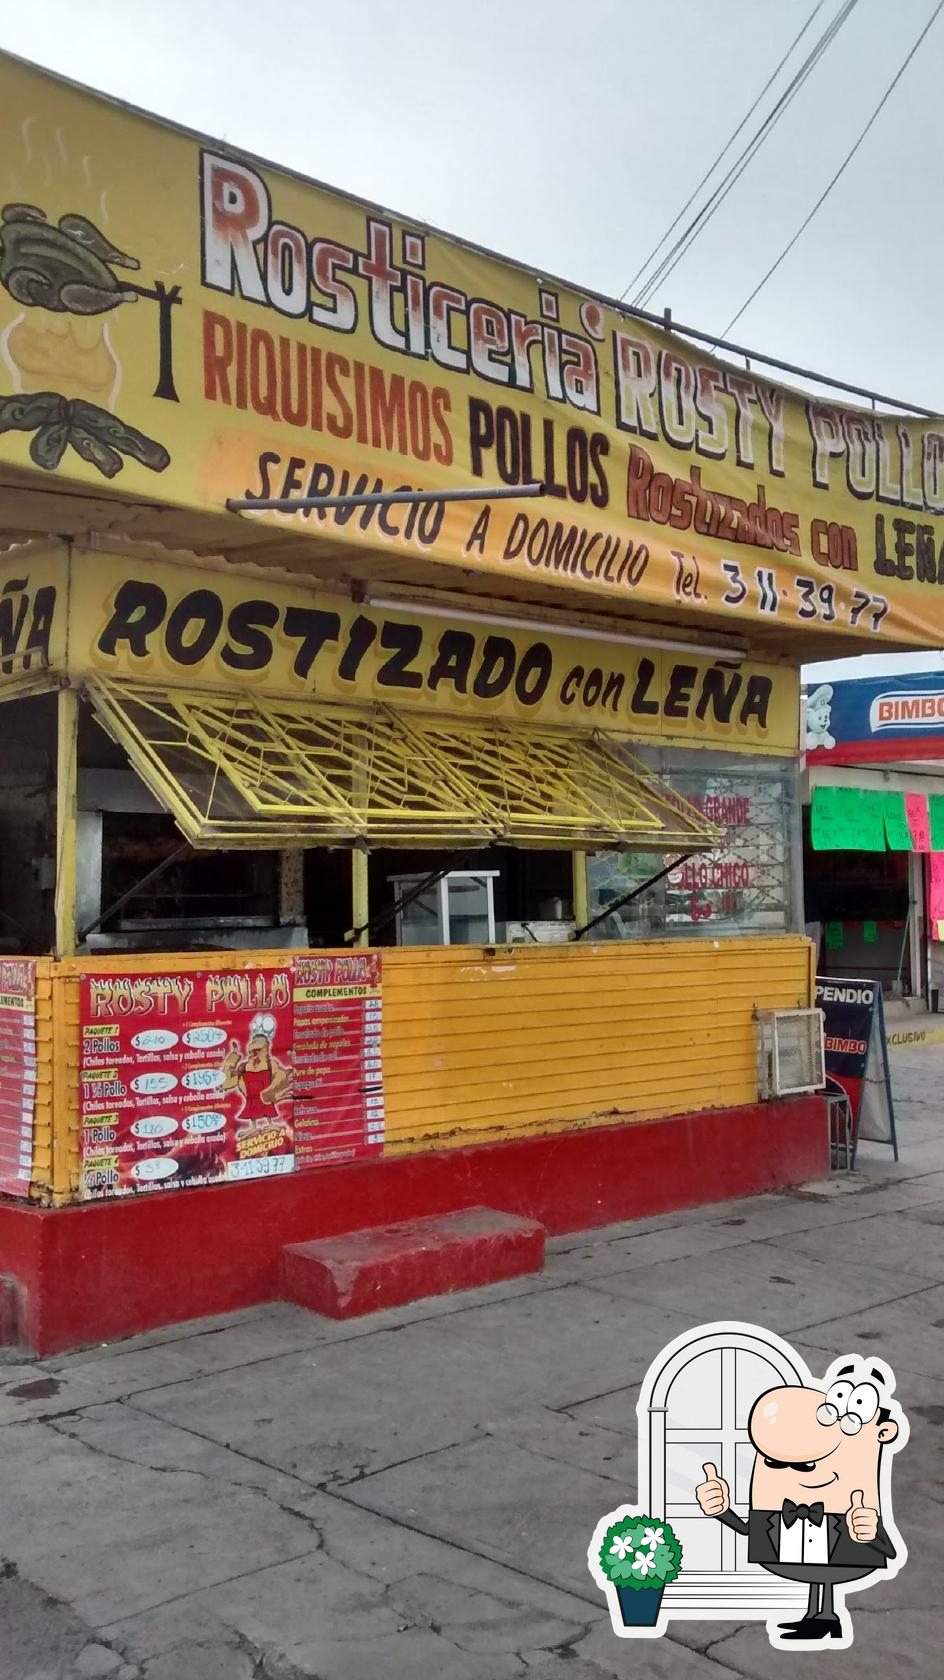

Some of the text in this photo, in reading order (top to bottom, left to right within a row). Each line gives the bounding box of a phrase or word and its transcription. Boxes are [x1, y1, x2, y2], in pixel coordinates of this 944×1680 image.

[202, 308, 454, 467] RIQUISIMOS
[468, 395, 610, 509] POLLOS
[612, 329, 785, 477] ROSTY
[245, 452, 445, 544] SERVICIO
[466, 505, 491, 554] A
[503, 512, 649, 587] DOMICILIO
[98, 579, 552, 706] ROSTIZADO
[630, 657, 773, 729] LEÑA
[90, 973, 290, 1017] ROSTY POLLO
[305, 986, 367, 998] COMPLEMENTOS
[815, 986, 874, 1004] PENDIO
[93, 1037, 120, 1052] Pollos
[824, 1037, 868, 1054] BIMBO
[104, 1080, 127, 1096] Pollo
[92, 1125, 116, 1142] Pollo
[95, 1170, 119, 1185] Pollo
